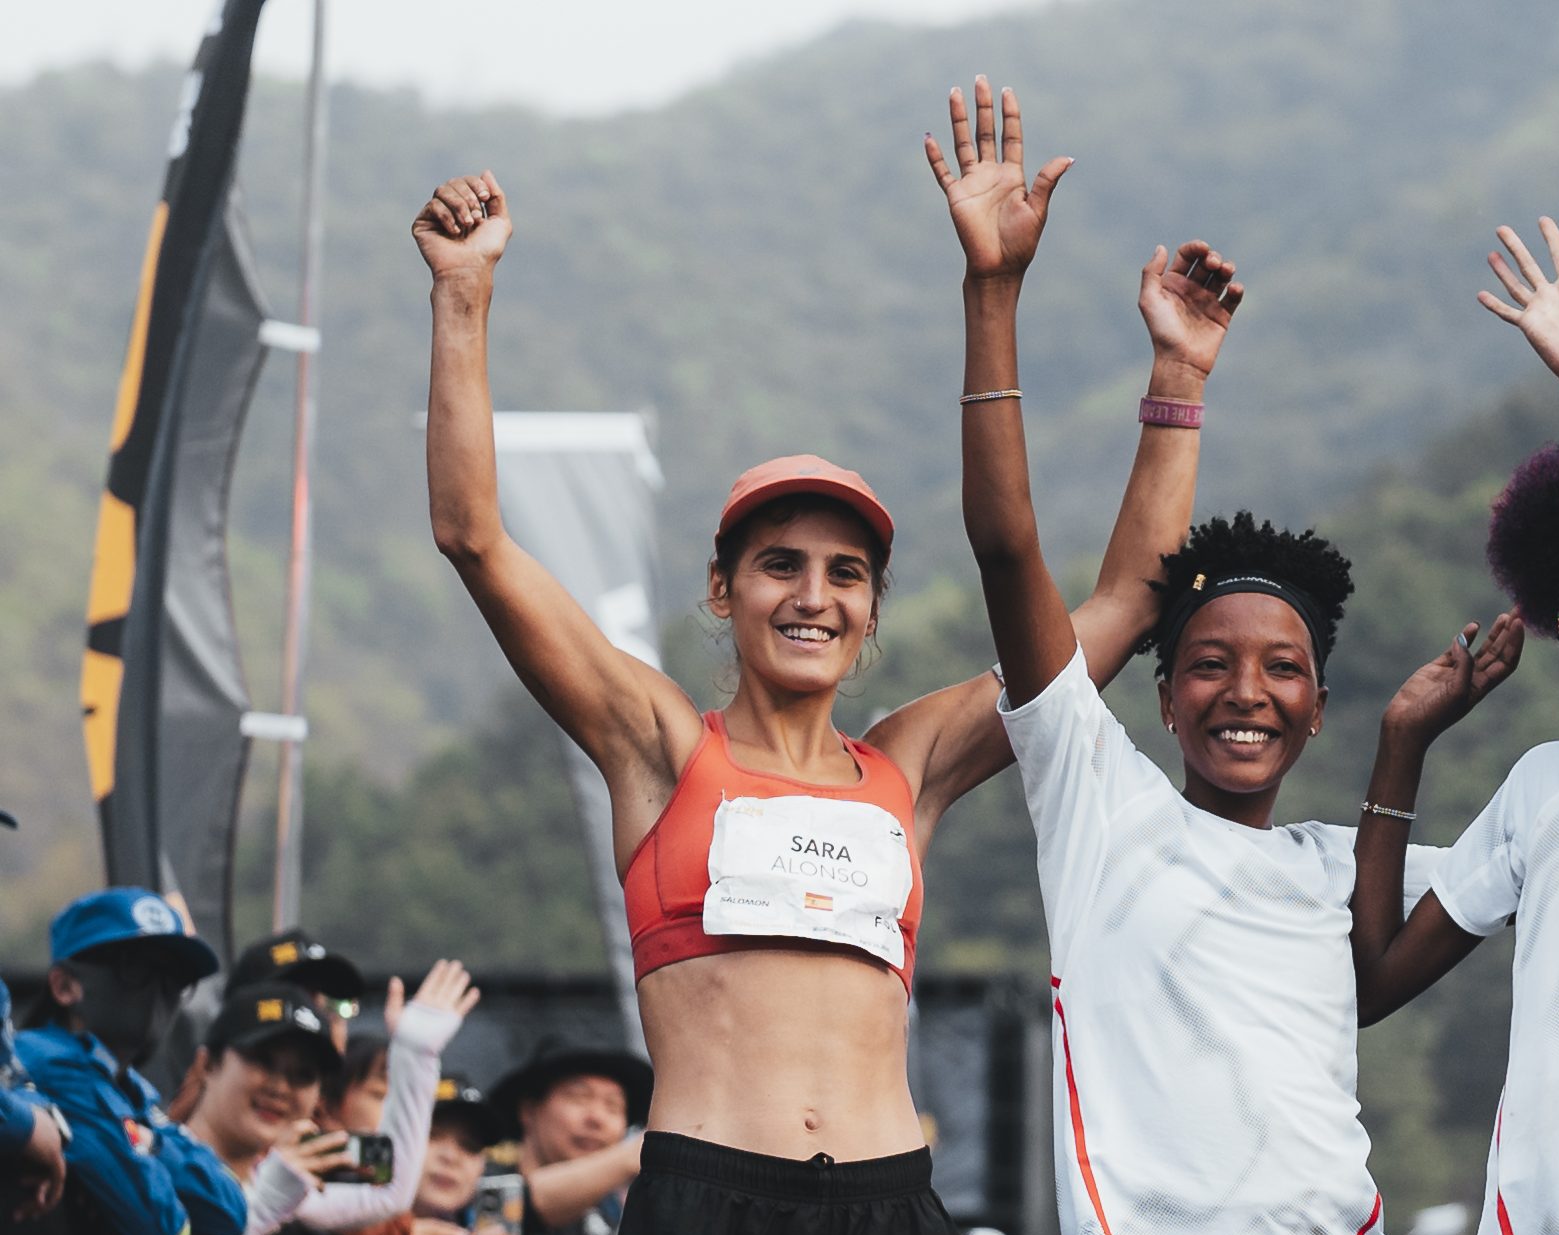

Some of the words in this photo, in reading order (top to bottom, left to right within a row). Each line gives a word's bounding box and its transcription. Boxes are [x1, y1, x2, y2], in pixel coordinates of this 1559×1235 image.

[790, 834, 852, 863] SARA
[771, 855, 868, 888] ALONSO
[720, 896, 770, 908] SALOMON
